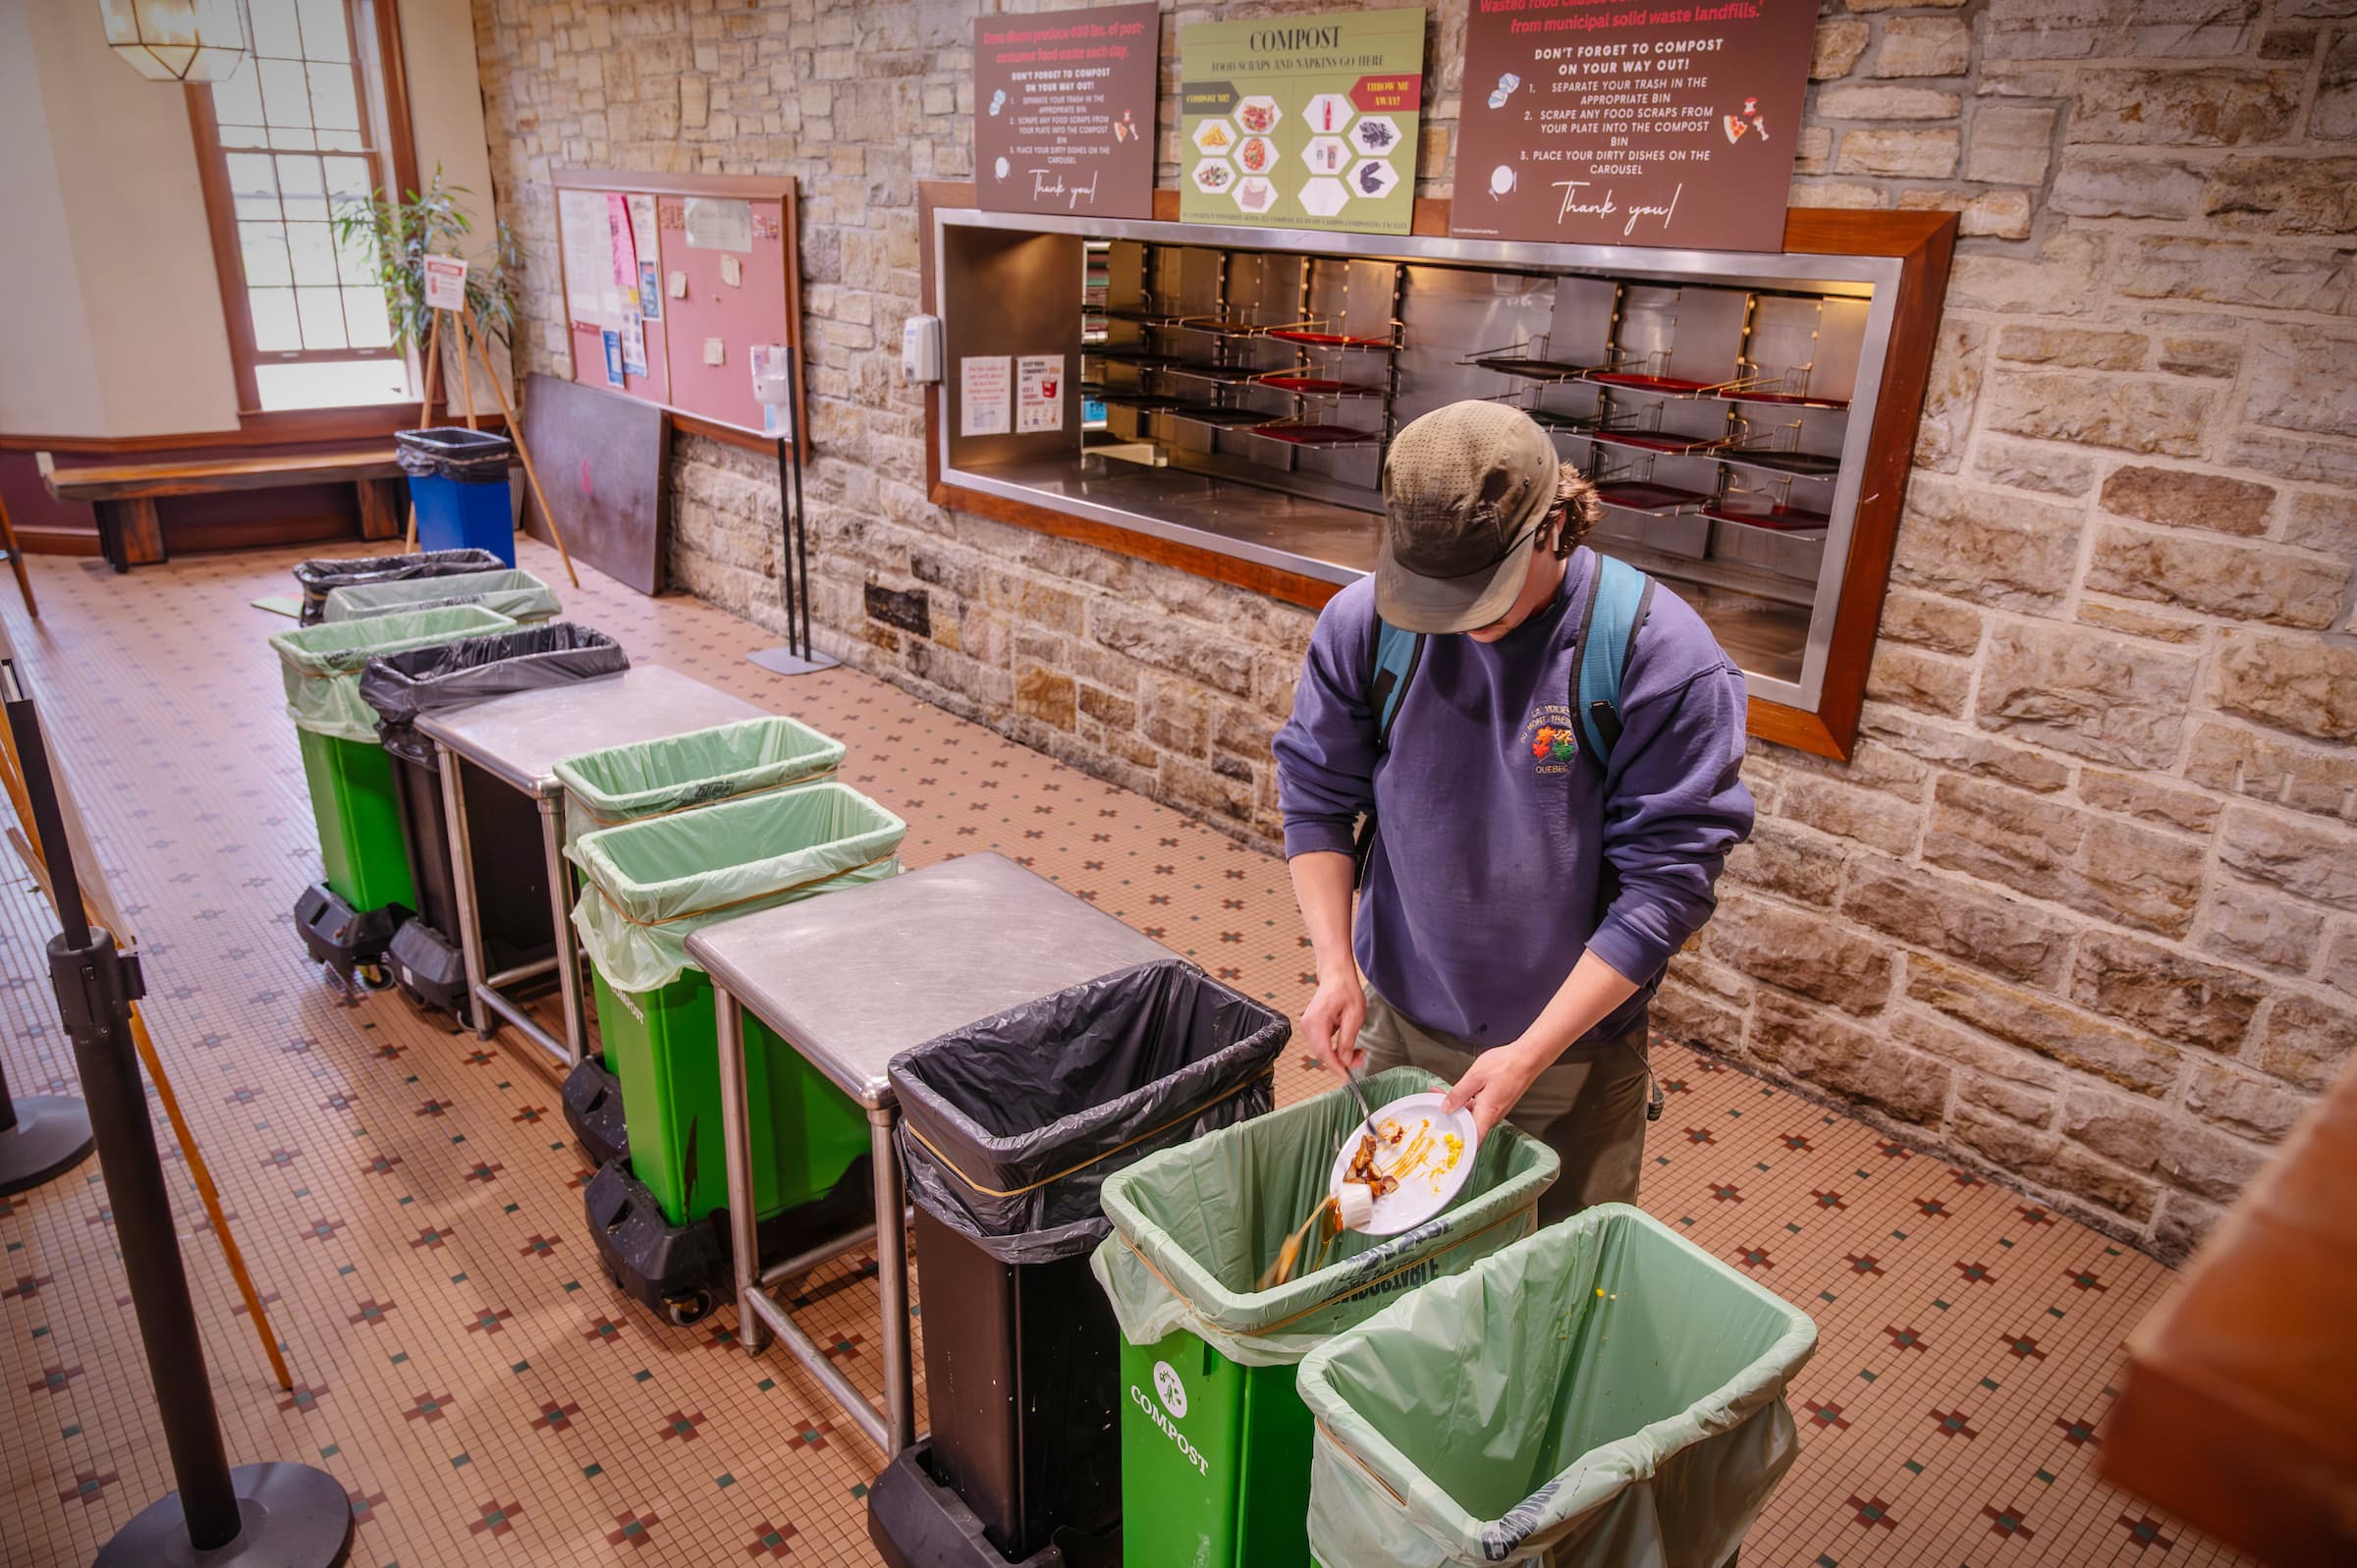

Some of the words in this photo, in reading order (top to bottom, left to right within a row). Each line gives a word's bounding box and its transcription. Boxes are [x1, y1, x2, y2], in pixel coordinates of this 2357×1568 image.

[1481, 0, 1525, 13] Wasted
[1510, 19, 1542, 32] from
[1544, 13, 1610, 31] municipal
[1613, 9, 1647, 27] solid
[1650, 10, 1691, 24] waste
[1249, 27, 1342, 52] COMPOST
[1534, 47, 1572, 60] DON'T
[1577, 44, 1627, 58] FORGET
[1632, 43, 1649, 55] TO
[1655, 38, 1724, 53] COMPOST
[1275, 59, 1293, 70] AND
[1296, 56, 1337, 69] NAPKINS
[1340, 56, 1355, 66] GO
[1358, 55, 1383, 66] HERE
[1559, 64, 1577, 76] ON
[1583, 62, 1617, 75] YOUR
[1622, 61, 1652, 73] WAY
[1657, 59, 1689, 71] OUT!
[1012, 72, 1032, 81] DON'T
[1034, 71, 1061, 80] FORGET
[1063, 70, 1072, 79] TO
[1074, 68, 1110, 78] COMPOST
[1038, 82, 1057, 91] YOUR
[1059, 81, 1074, 90] WAY
[1076, 81, 1095, 90] OUT!
[1529, 83, 1536, 93] 1.
[1552, 81, 1599, 92] SEPARATE
[1602, 80, 1630, 90] YOUR
[1634, 79, 1667, 89] TRASH
[1671, 78, 1682, 87] IN
[1687, 77, 1708, 87] THE
[1580, 94, 1647, 105] APPROPRIATE
[1652, 93, 1671, 103] BIN
[1524, 111, 1533, 121] 2.
[1540, 110, 1576, 120] SCRAPE
[1579, 109, 1601, 119] ANY
[1604, 109, 1634, 119] FOOD
[1637, 107, 1677, 118] SCRAPS
[1681, 106, 1713, 117] FROM
[1541, 124, 1568, 134] YOUR
[1570, 123, 1599, 134] PLATE
[1602, 123, 1627, 133] INTO
[1631, 122, 1651, 133] THE
[1654, 121, 1710, 133] COMPOST
[1611, 136, 1628, 146] BIN
[1520, 150, 1529, 161] 3.
[1532, 150, 1562, 161] PLACE
[1565, 150, 1593, 161] YOUR
[1596, 150, 1625, 161] DIRTY
[1628, 150, 1666, 161] DISHES
[1669, 150, 1686, 161] ON
[1690, 150, 1711, 161] THE
[1590, 164, 1643, 175] CAROUSEL
[1028, 169, 1065, 201] Thank
[1069, 171, 1098, 209] you!
[1552, 181, 1617, 225] Thank
[1624, 183, 1682, 236] you!
[1131, 1385, 1208, 1476] COMPOST
